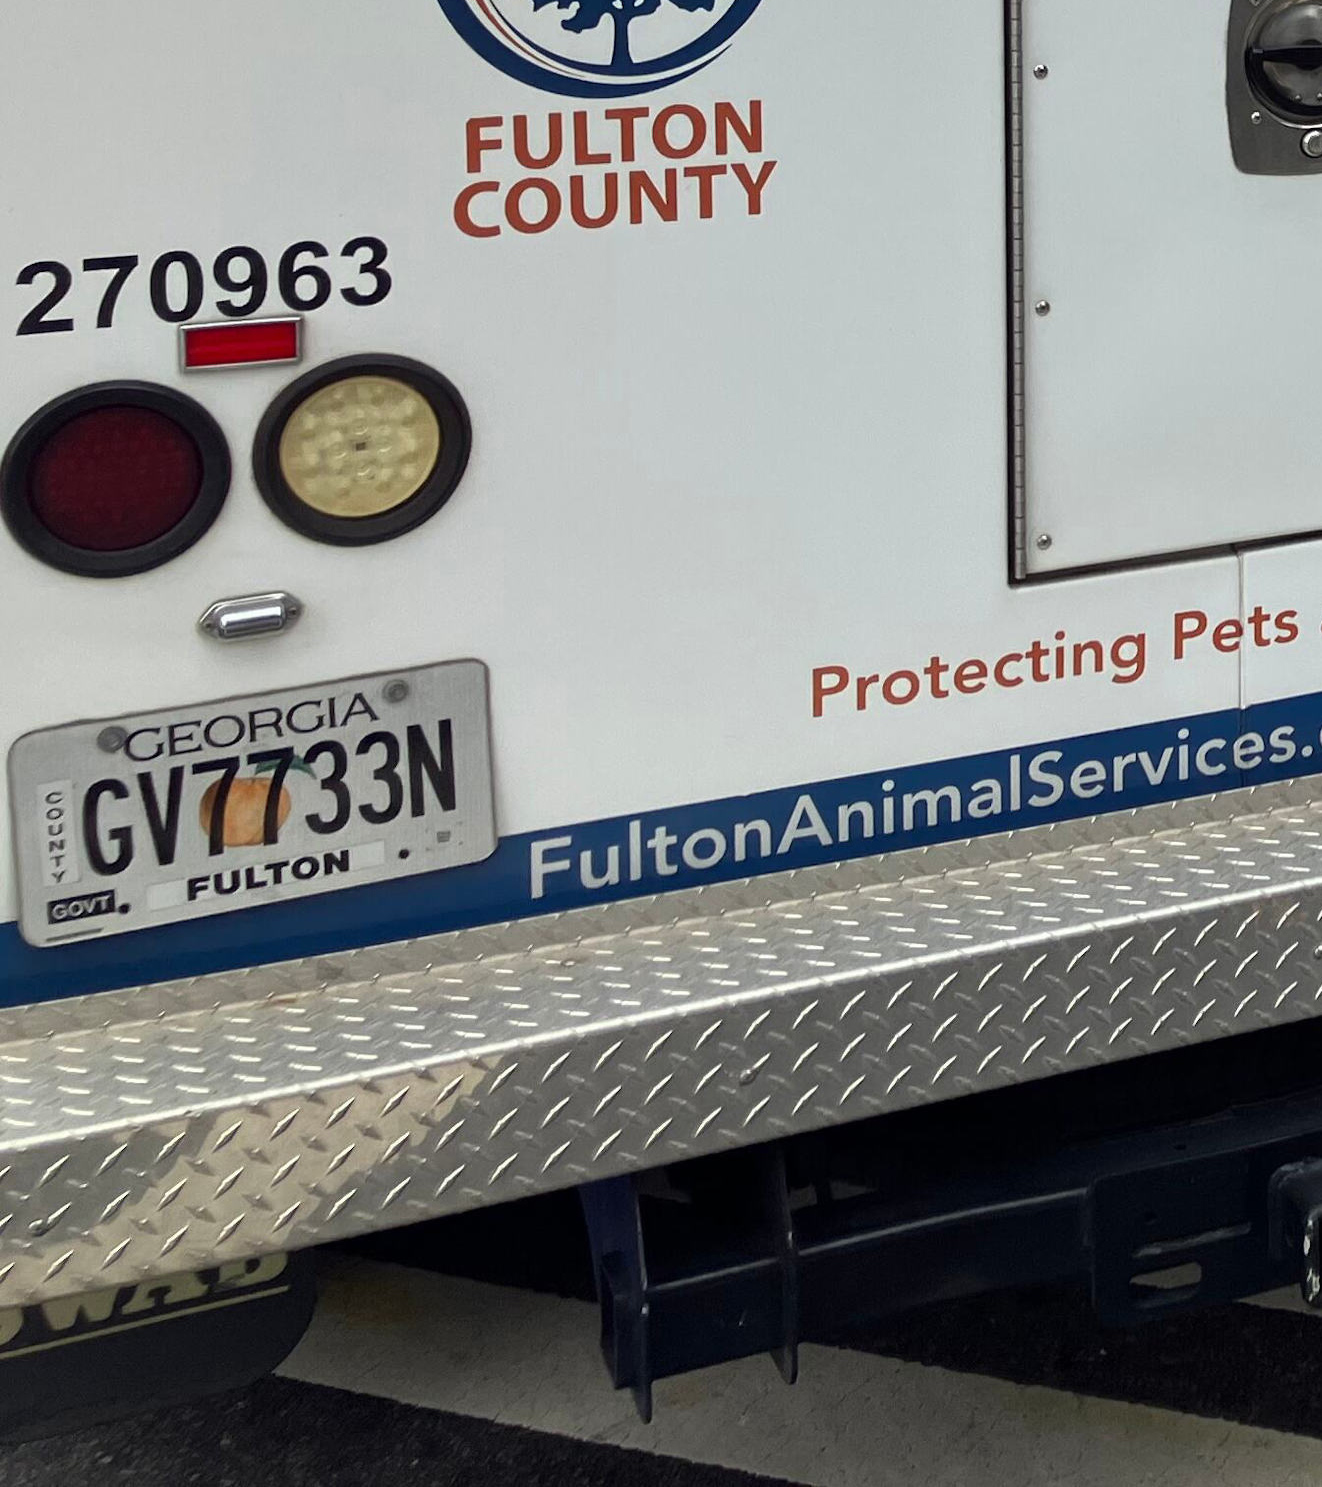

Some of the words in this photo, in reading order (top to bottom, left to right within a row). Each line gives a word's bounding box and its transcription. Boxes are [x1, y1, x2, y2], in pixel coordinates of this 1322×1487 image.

[464, 99, 763, 174] FULTON
[452, 160, 779, 238] COUNTY
[14, 236, 394, 336] 270963
[811, 628, 1148, 718] Protecting
[1173, 606, 1299, 660] Pets
[122, 692, 379, 762] GEORGIA
[82, 718, 457, 876] GV7733N
[45, 791, 66, 884] COUNTY
[187, 849, 351, 901] FULTON
[51, 894, 111, 920] GOVT
